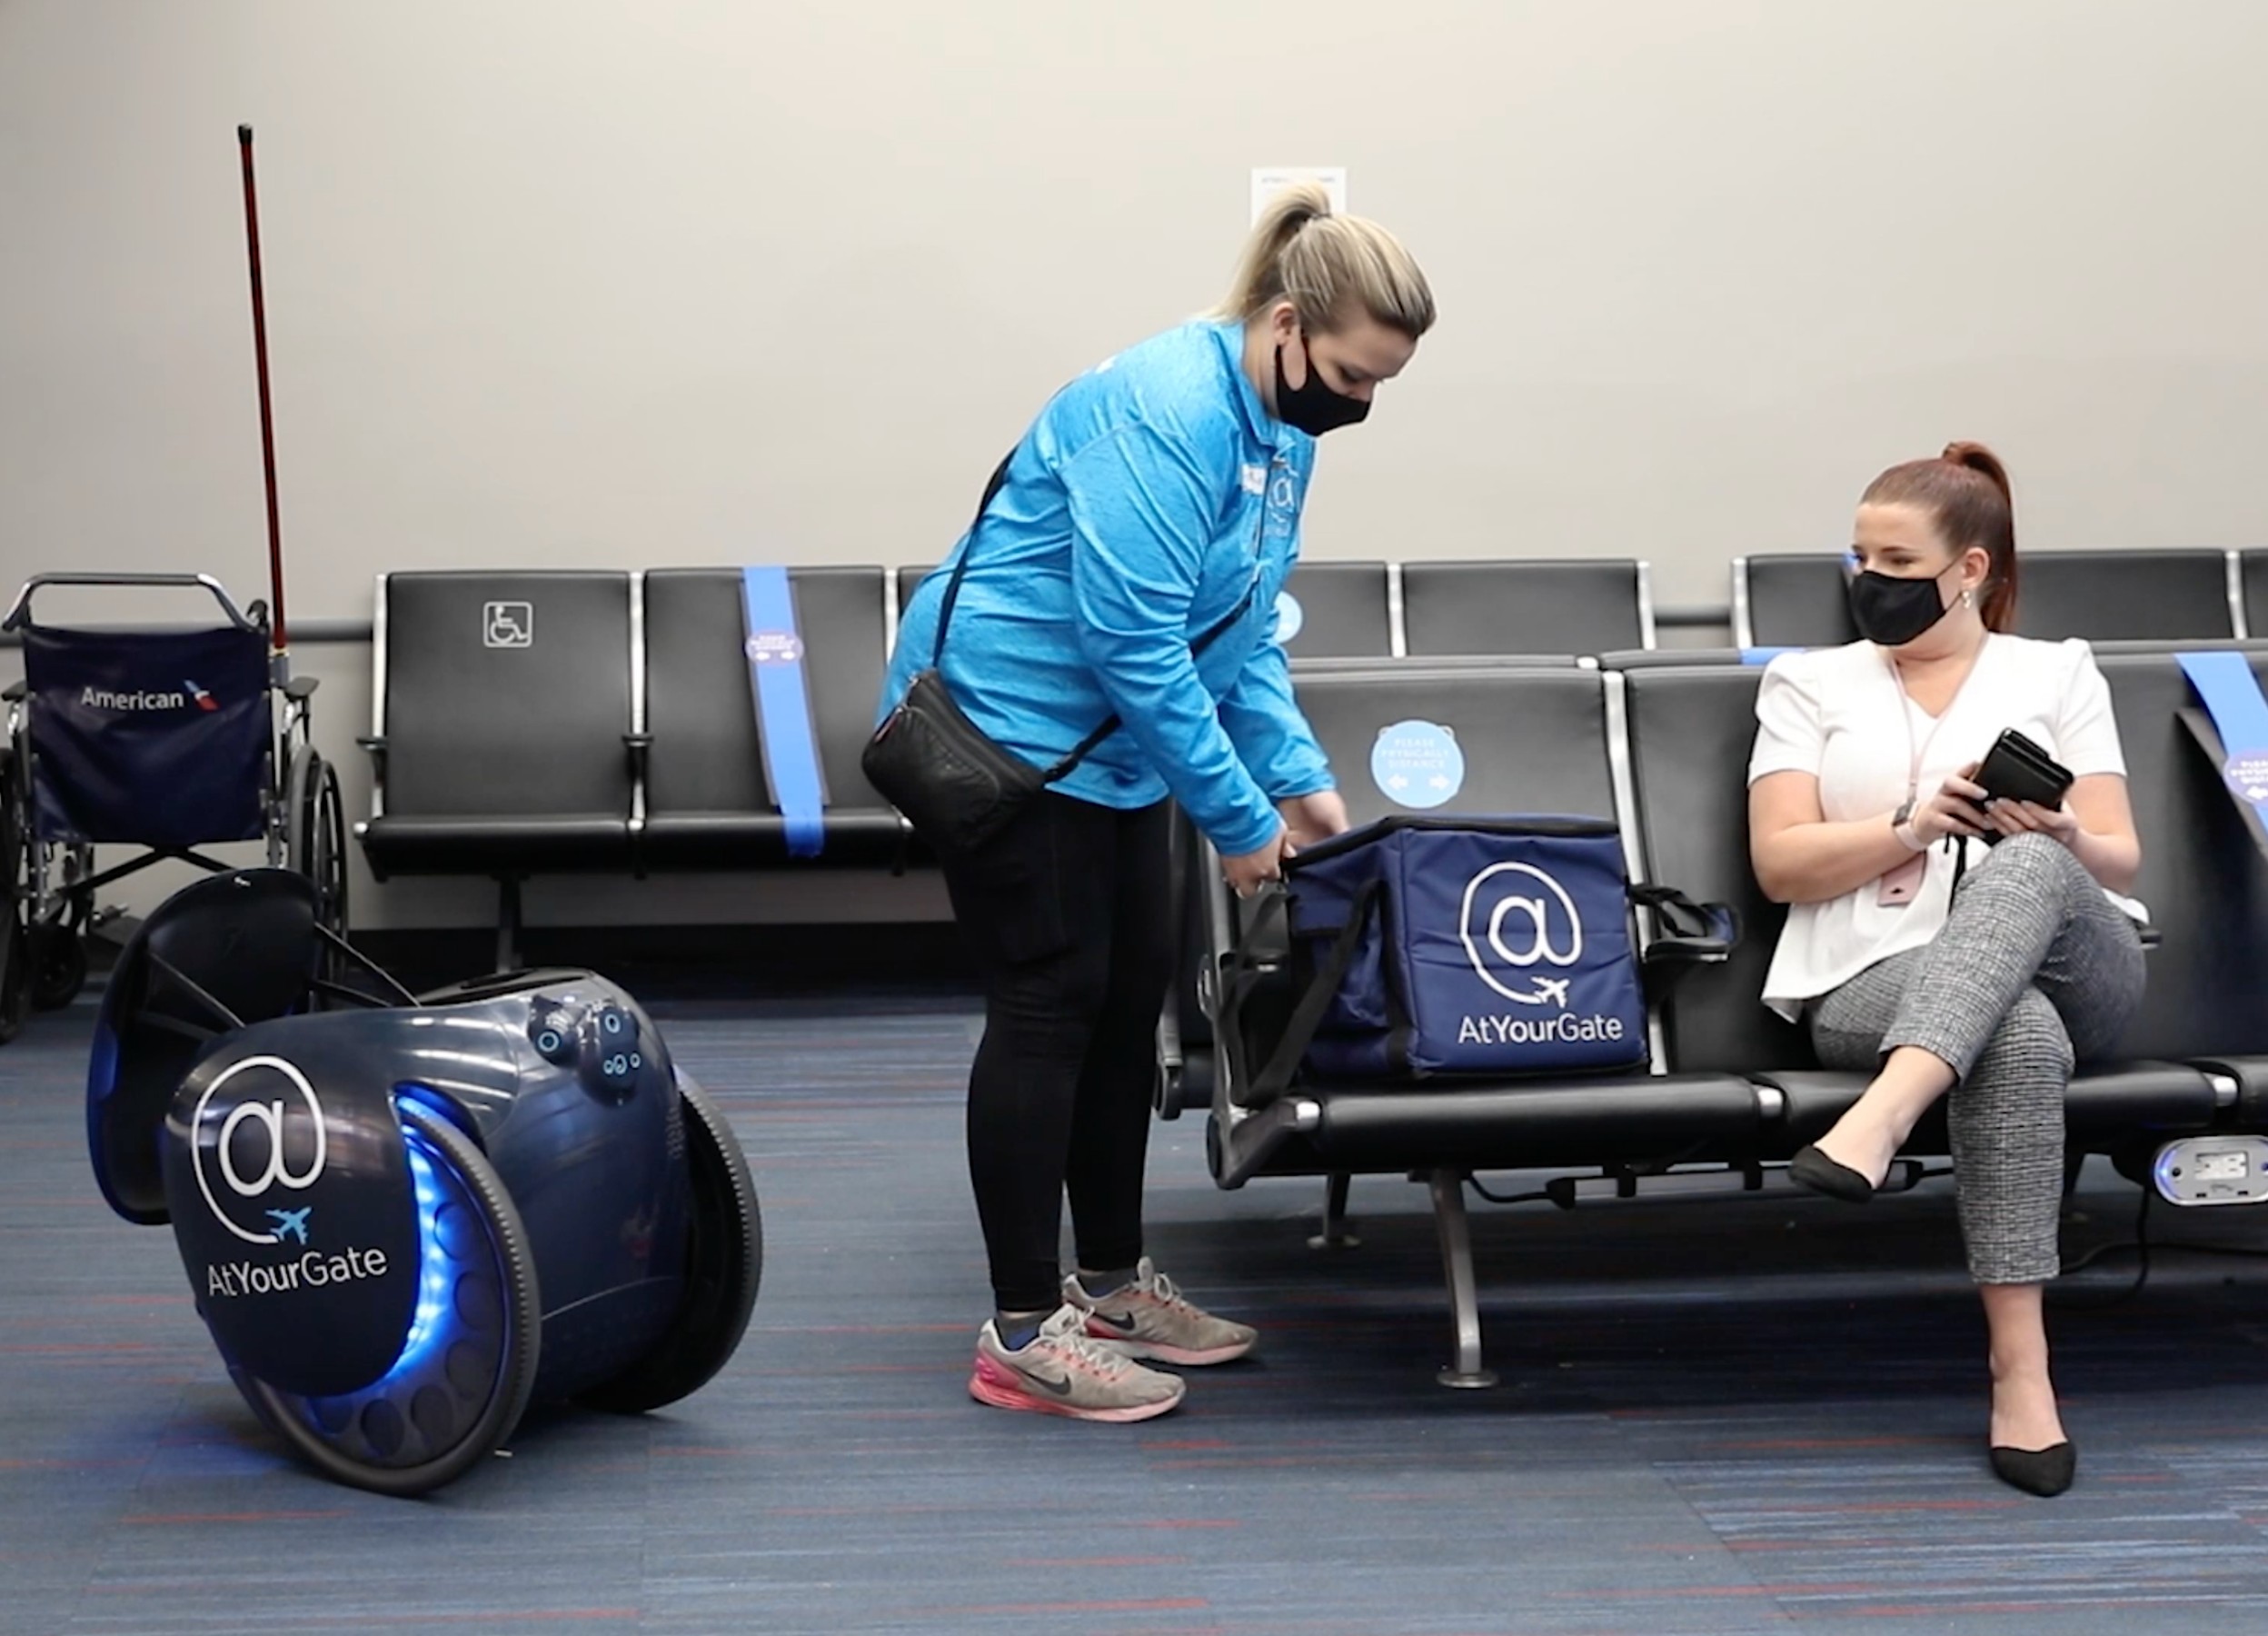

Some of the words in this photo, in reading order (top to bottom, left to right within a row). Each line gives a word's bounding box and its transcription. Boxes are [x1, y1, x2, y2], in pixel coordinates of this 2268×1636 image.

[81, 685, 184, 711] American
[1394, 737, 1435, 748] PLEASE
[1388, 759, 1445, 769] DISTANCE
[1457, 1012, 1624, 1044] AtYourGate
[206, 1246, 388, 1297] AtYourGate
